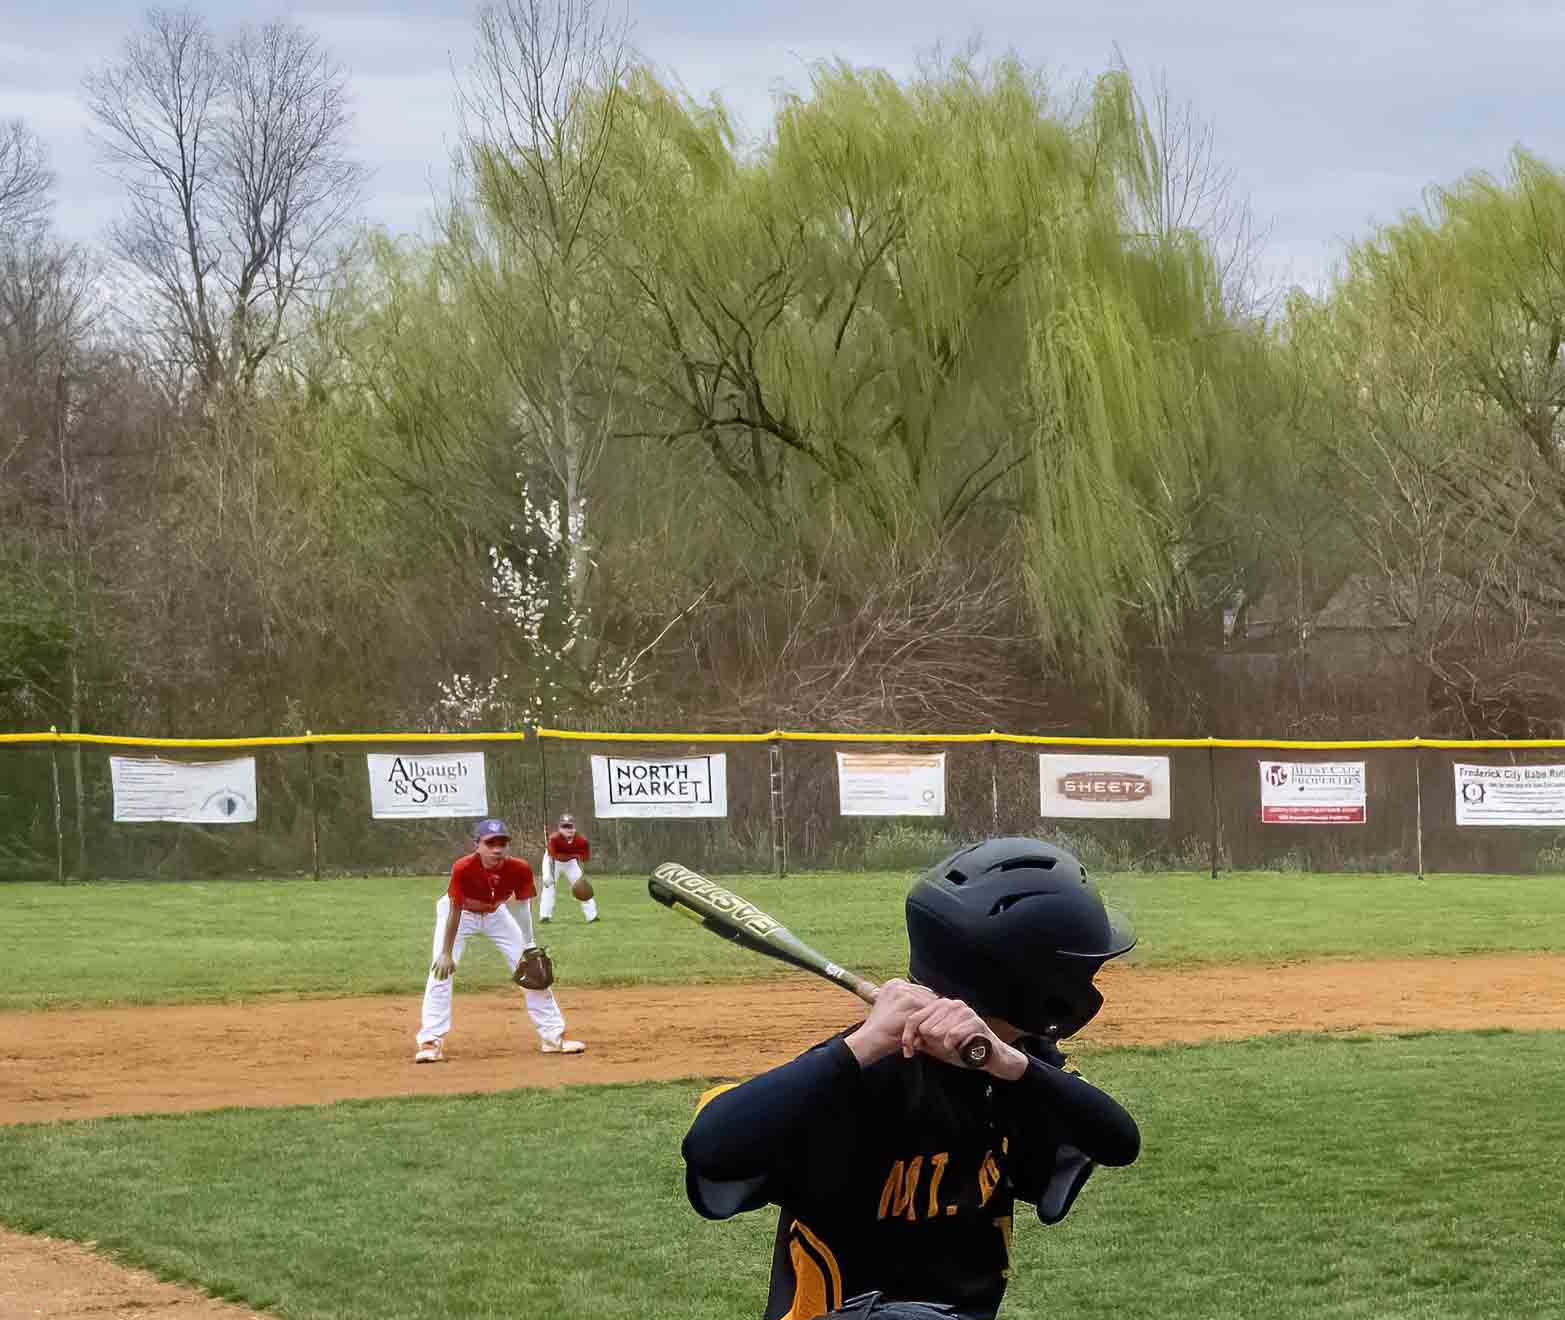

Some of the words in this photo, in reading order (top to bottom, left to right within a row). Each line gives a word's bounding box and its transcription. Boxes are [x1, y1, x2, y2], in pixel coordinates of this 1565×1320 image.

[388, 758, 467, 781] Albaugh
[617, 765, 688, 780] NORTH
[1459, 768, 1501, 778] Frederick
[1504, 770, 1521, 780] City
[394, 780, 408, 794] &
[412, 777, 458, 803] Sons
[618, 780, 702, 801] MARKET
[1064, 781, 1145, 793] SHEETZ
[655, 862, 788, 936] EASTON
